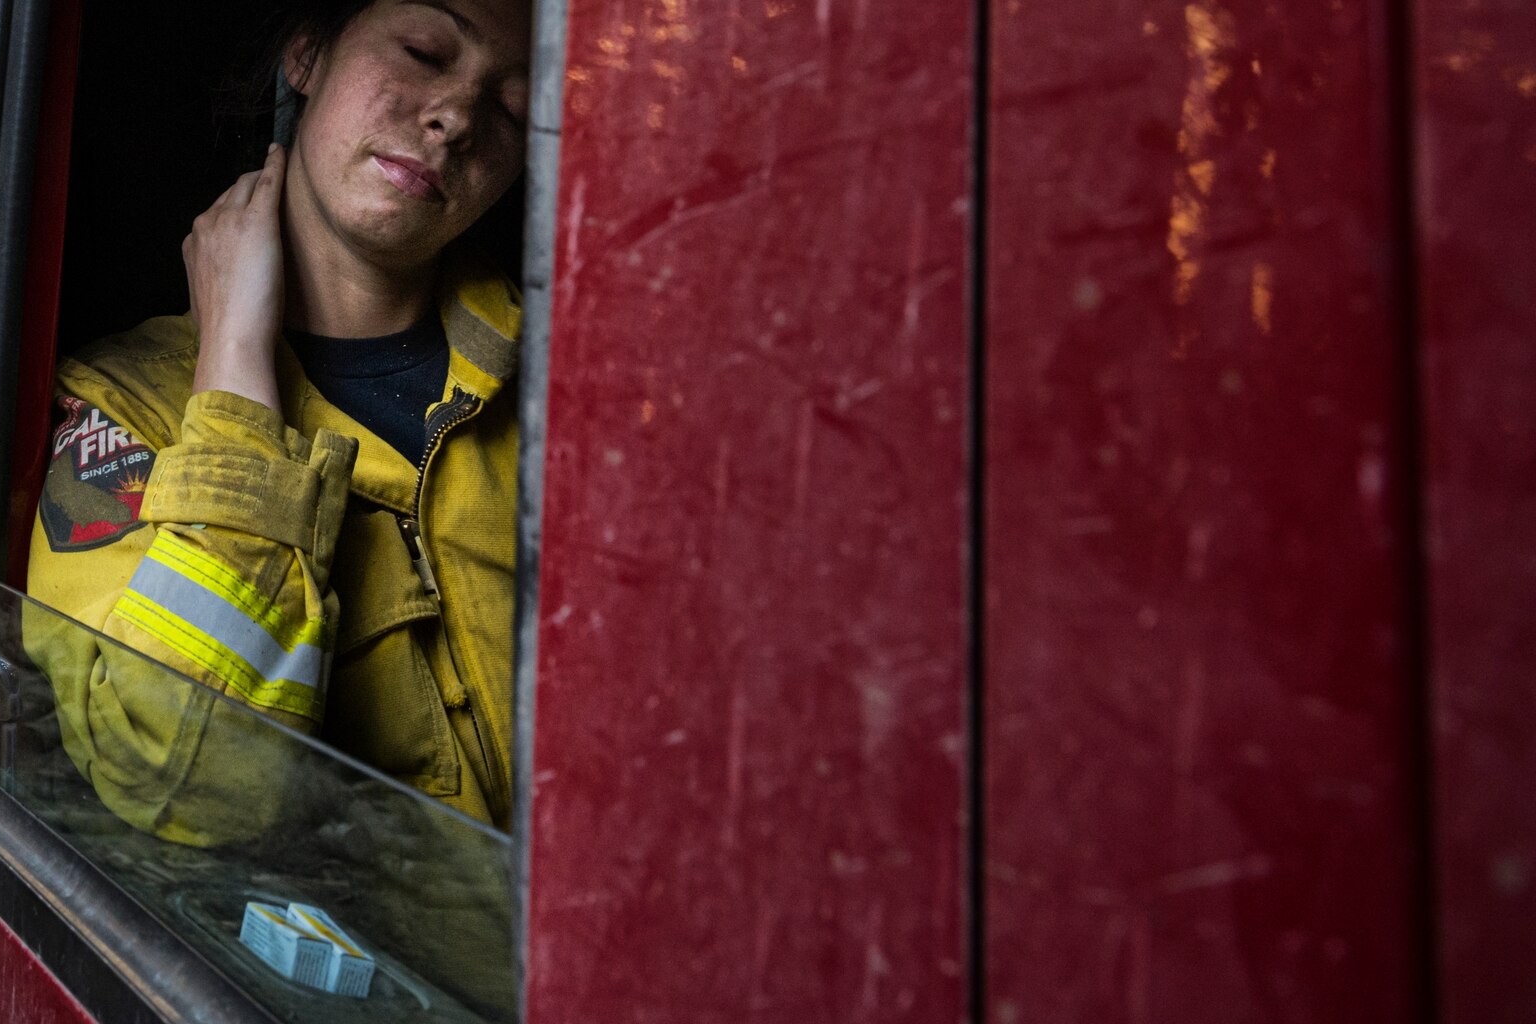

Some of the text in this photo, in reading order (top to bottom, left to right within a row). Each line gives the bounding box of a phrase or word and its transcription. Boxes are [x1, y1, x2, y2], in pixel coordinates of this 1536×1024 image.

[54, 408, 109, 456] CAL
[80, 451, 150, 480] SINCE 1885
